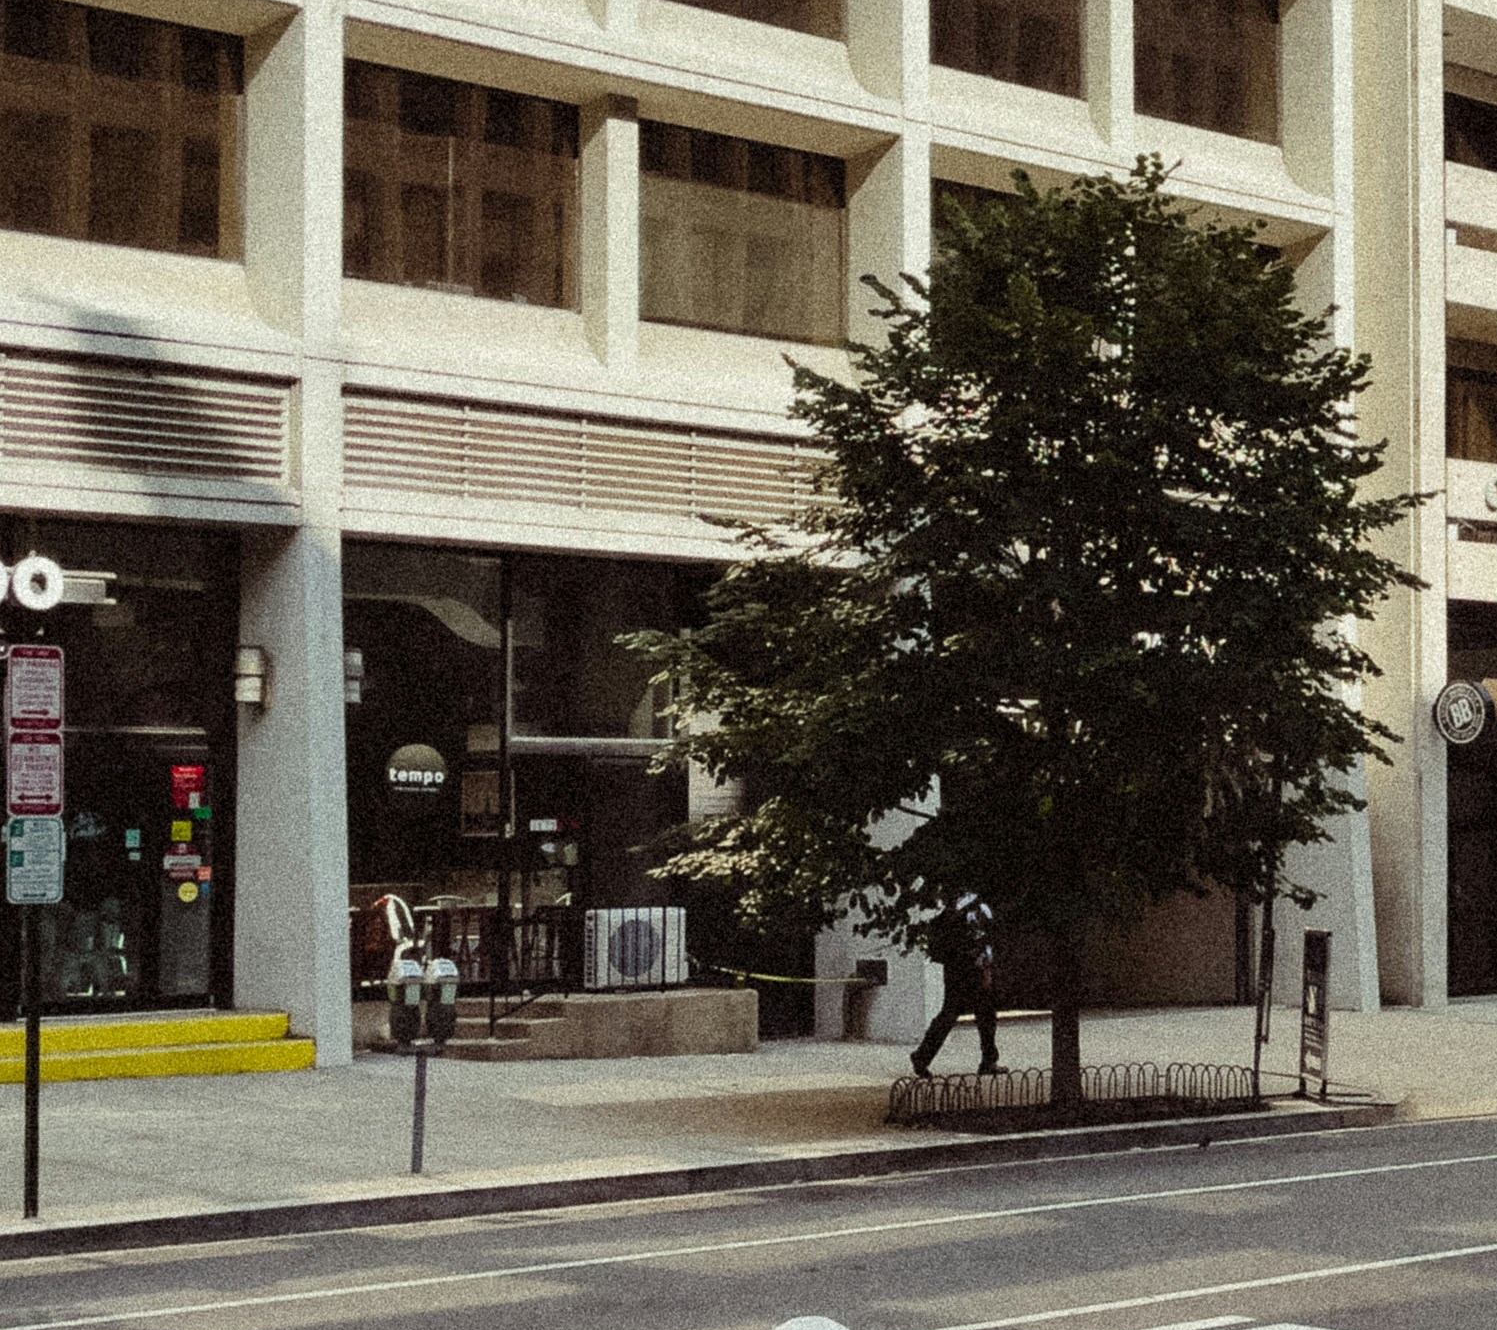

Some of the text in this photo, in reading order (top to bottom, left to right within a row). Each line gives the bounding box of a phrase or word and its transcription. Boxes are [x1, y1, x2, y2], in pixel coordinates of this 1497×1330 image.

[0, 556, 64, 611] o
[1448, 697, 1474, 729] BB
[388, 766, 445, 786] tempo
